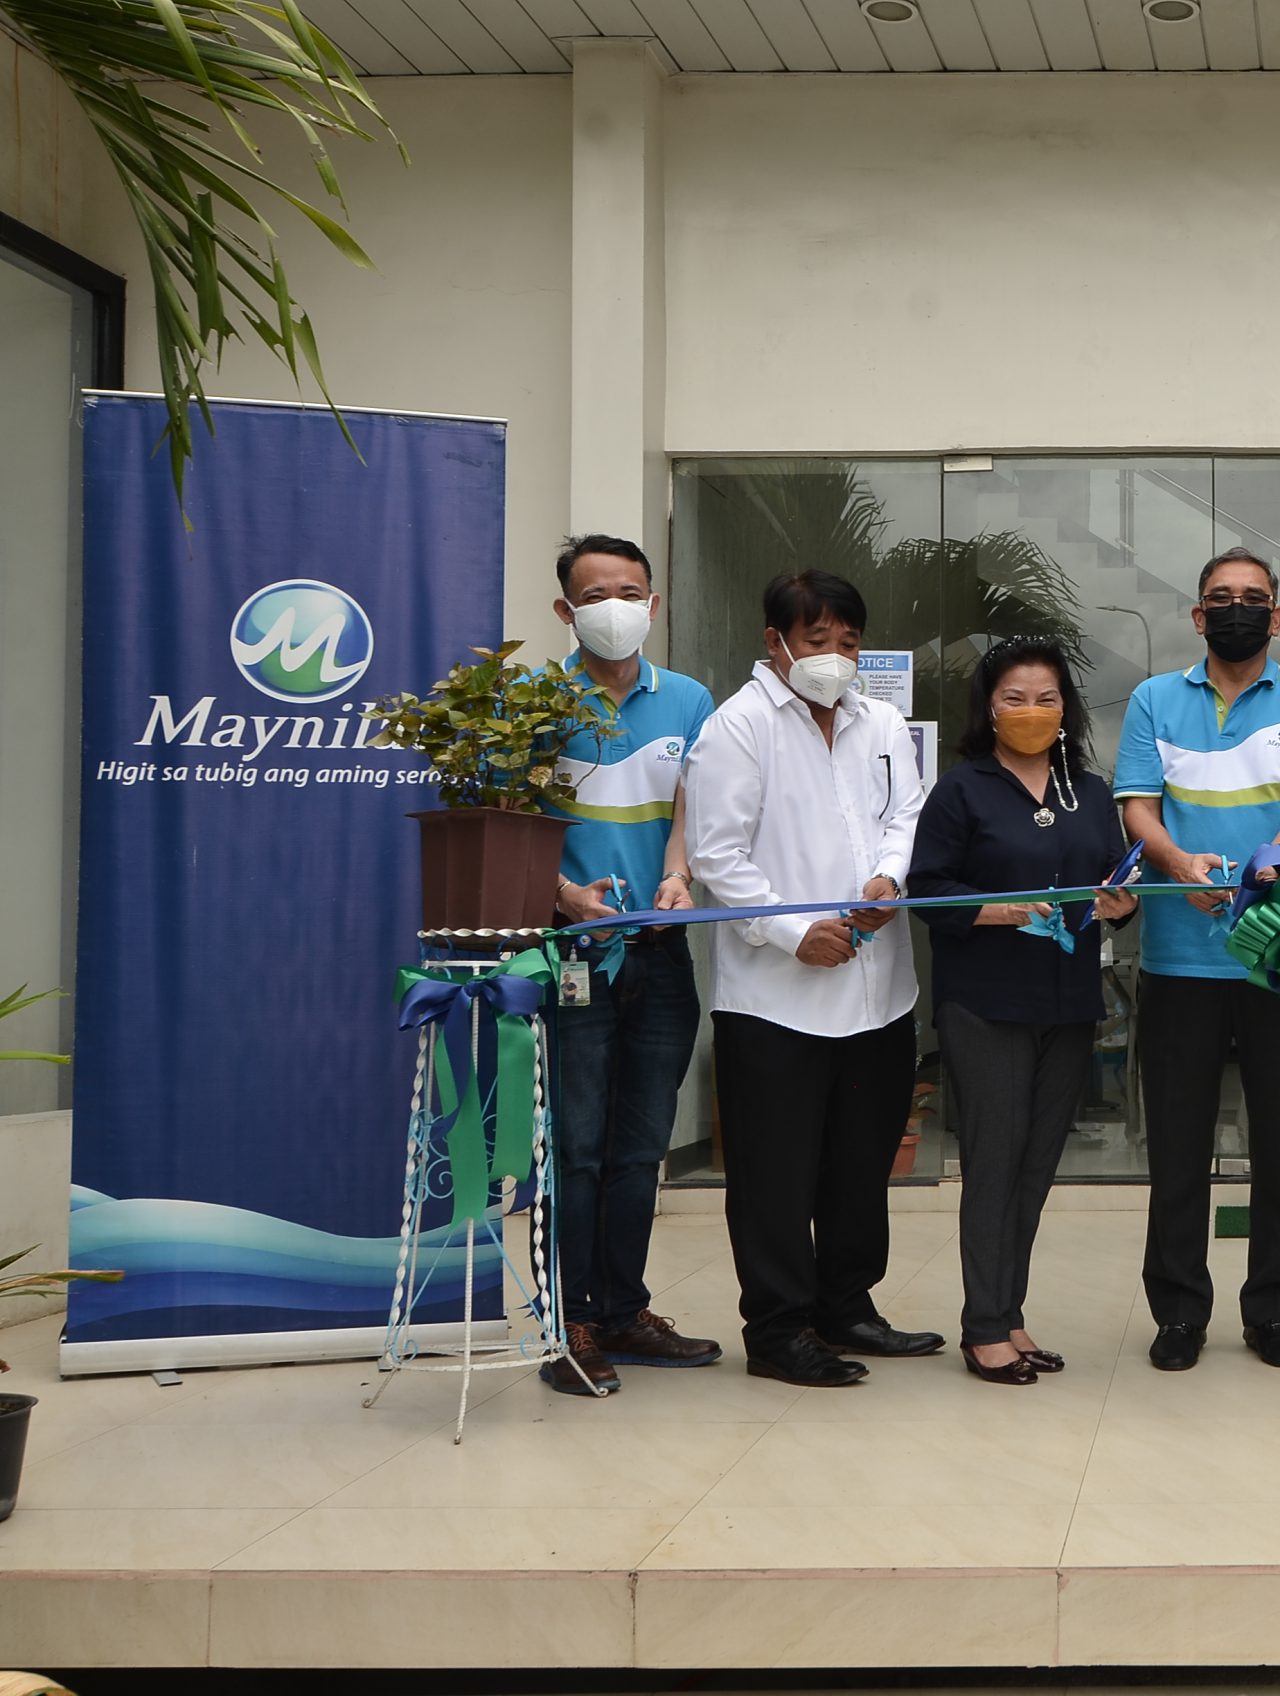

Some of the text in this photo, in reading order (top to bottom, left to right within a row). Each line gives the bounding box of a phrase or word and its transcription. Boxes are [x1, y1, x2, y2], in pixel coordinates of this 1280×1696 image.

[858, 657, 894, 668] OTICE
[134, 694, 428, 762] Maynil
[97, 761, 157, 787] Higit
[161, 766, 189, 782] sa
[195, 761, 258, 789] tubig
[263, 768, 310, 788] ang
[315, 764, 390, 789] aming
